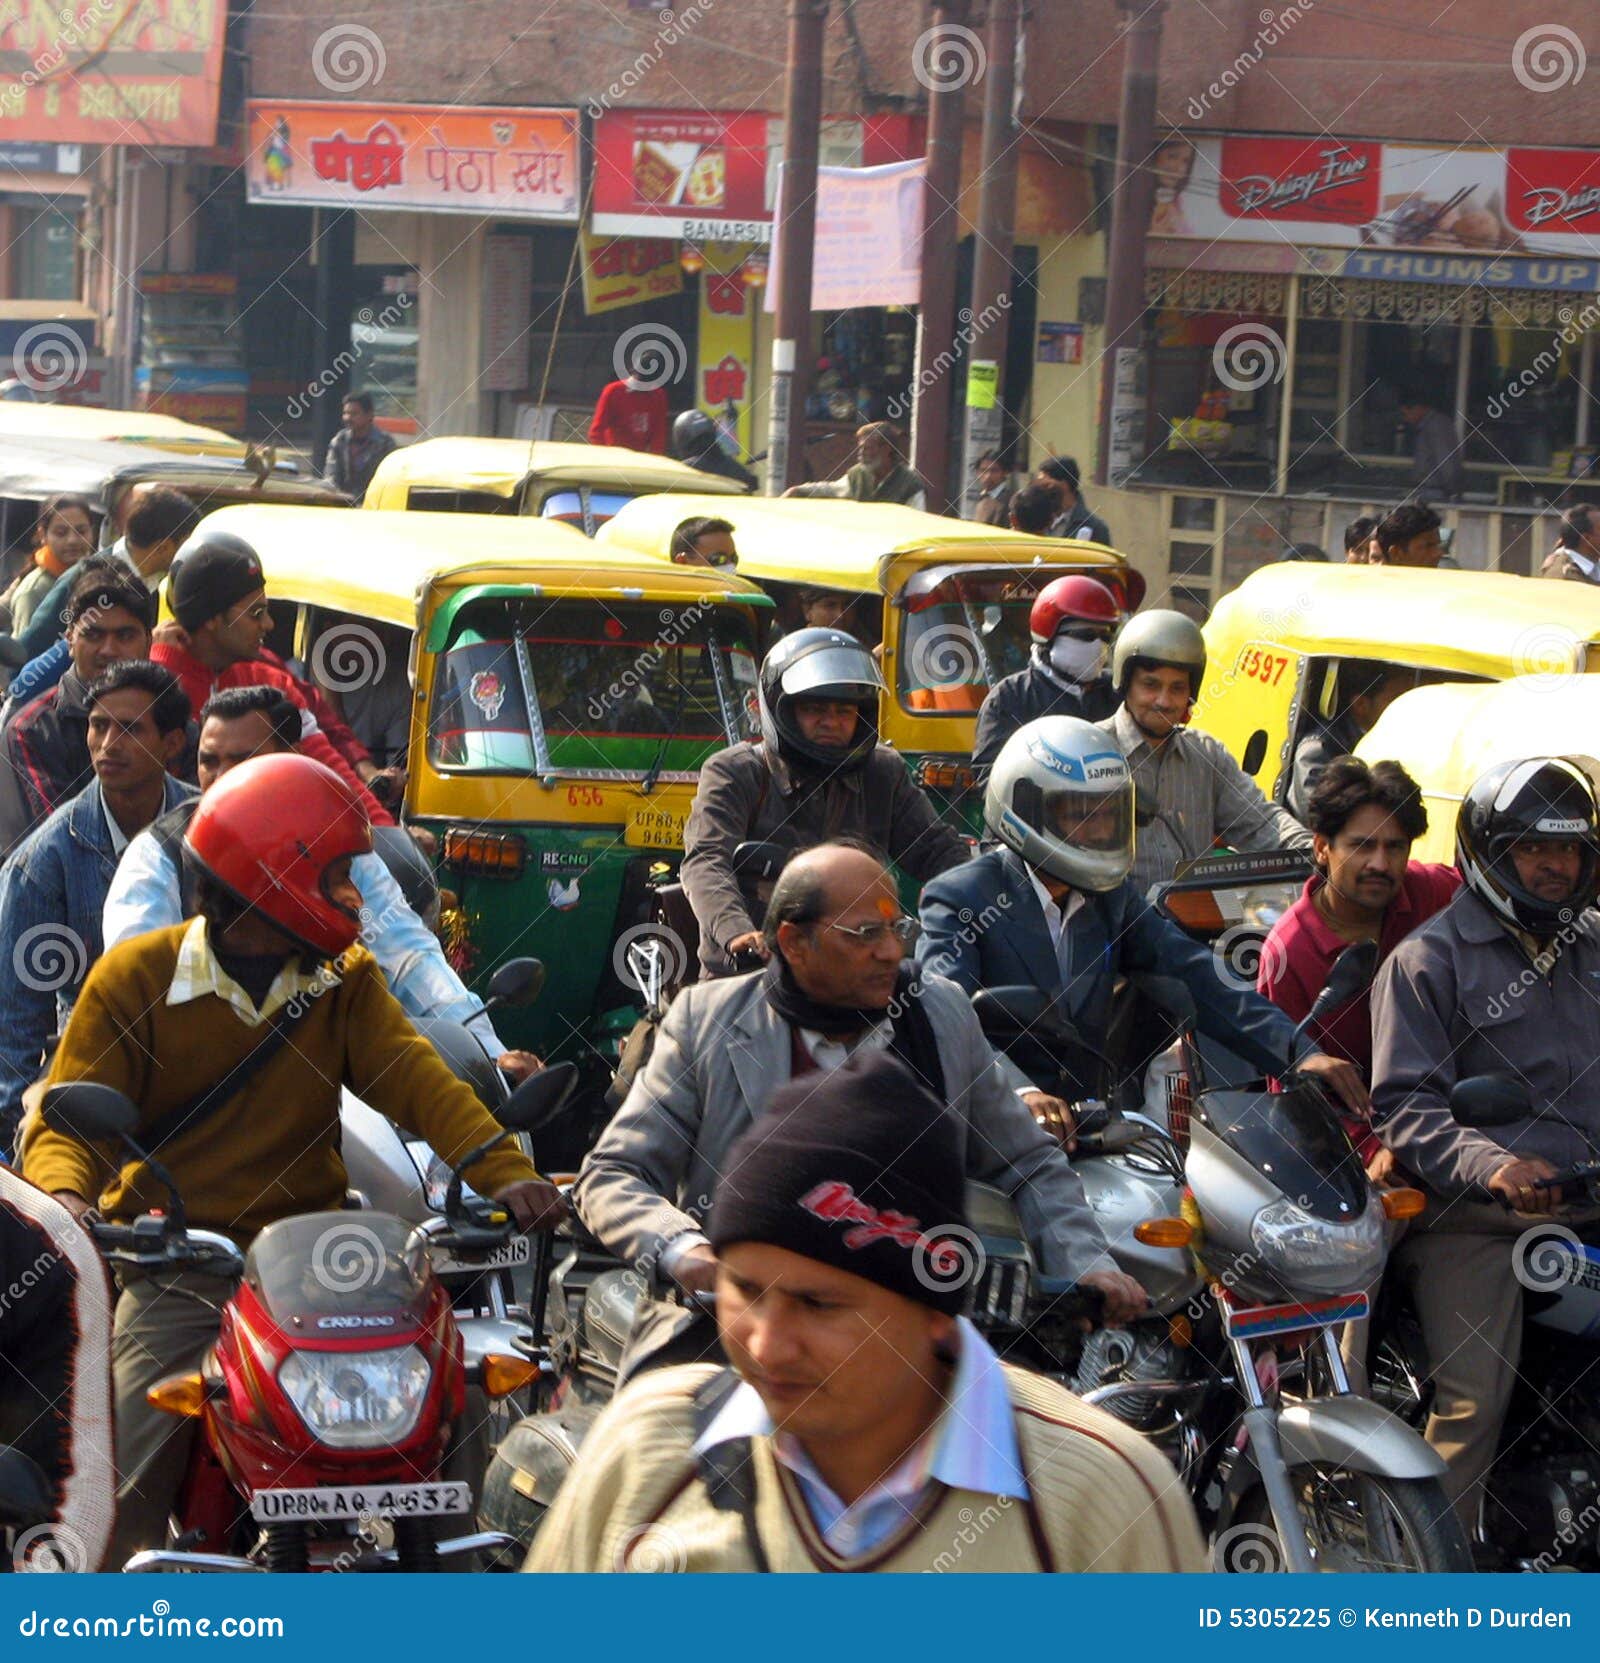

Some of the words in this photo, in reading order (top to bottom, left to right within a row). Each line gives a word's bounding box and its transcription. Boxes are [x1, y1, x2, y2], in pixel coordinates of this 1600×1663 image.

[426, 128, 497, 194] पेठा
[682, 219, 763, 241] BANARSI
[1357, 253, 1512, 283] THUMS
[1528, 261, 1588, 286] UP
[1240, 648, 1289, 688] 1597
[567, 783, 604, 807] 656
[636, 811, 688, 830] UP80-A
[1548, 821, 1582, 830] PILOT
[1193, 862, 1247, 876] KINETIC
[1250, 856, 1291, 869] HONDA
